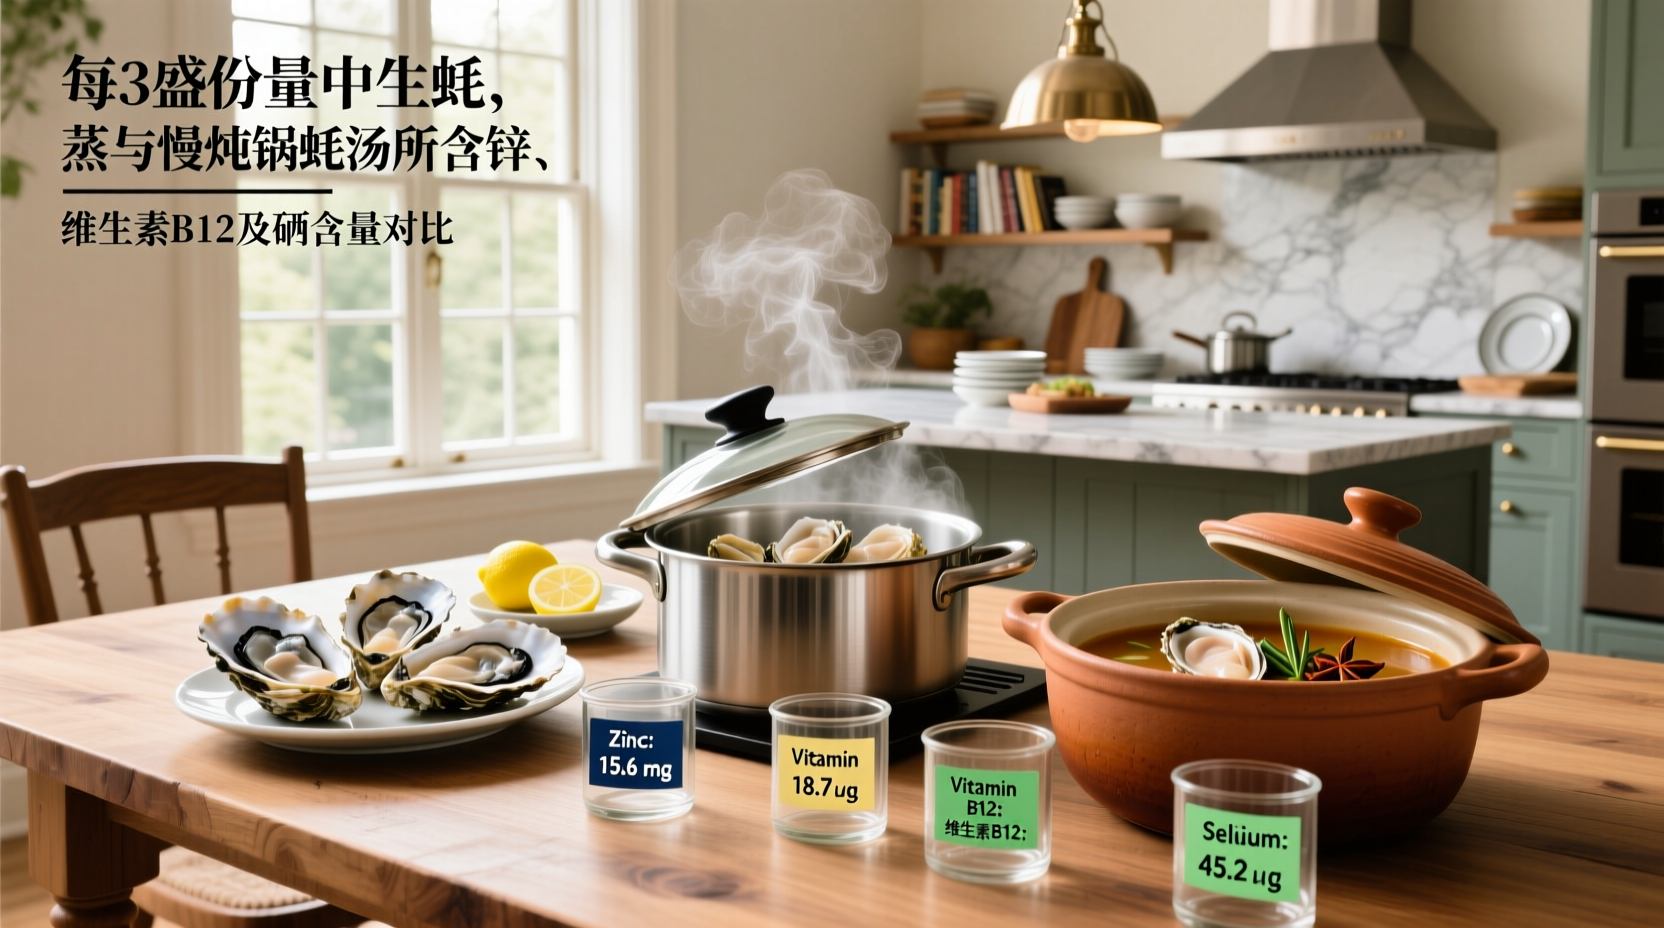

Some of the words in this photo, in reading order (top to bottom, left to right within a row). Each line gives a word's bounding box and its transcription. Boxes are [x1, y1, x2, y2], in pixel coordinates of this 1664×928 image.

[608, 729, 654, 749] Zinc:
[599, 755, 638, 777] 15.6
[643, 761, 672, 782] mg
[791, 747, 859, 768] Vitamin
[792, 775, 832, 797] 18.7
[950, 775, 1017, 797] Vitamin
[967, 799, 1002, 817] B12:
[1198, 854, 1248, 882] 45.2
